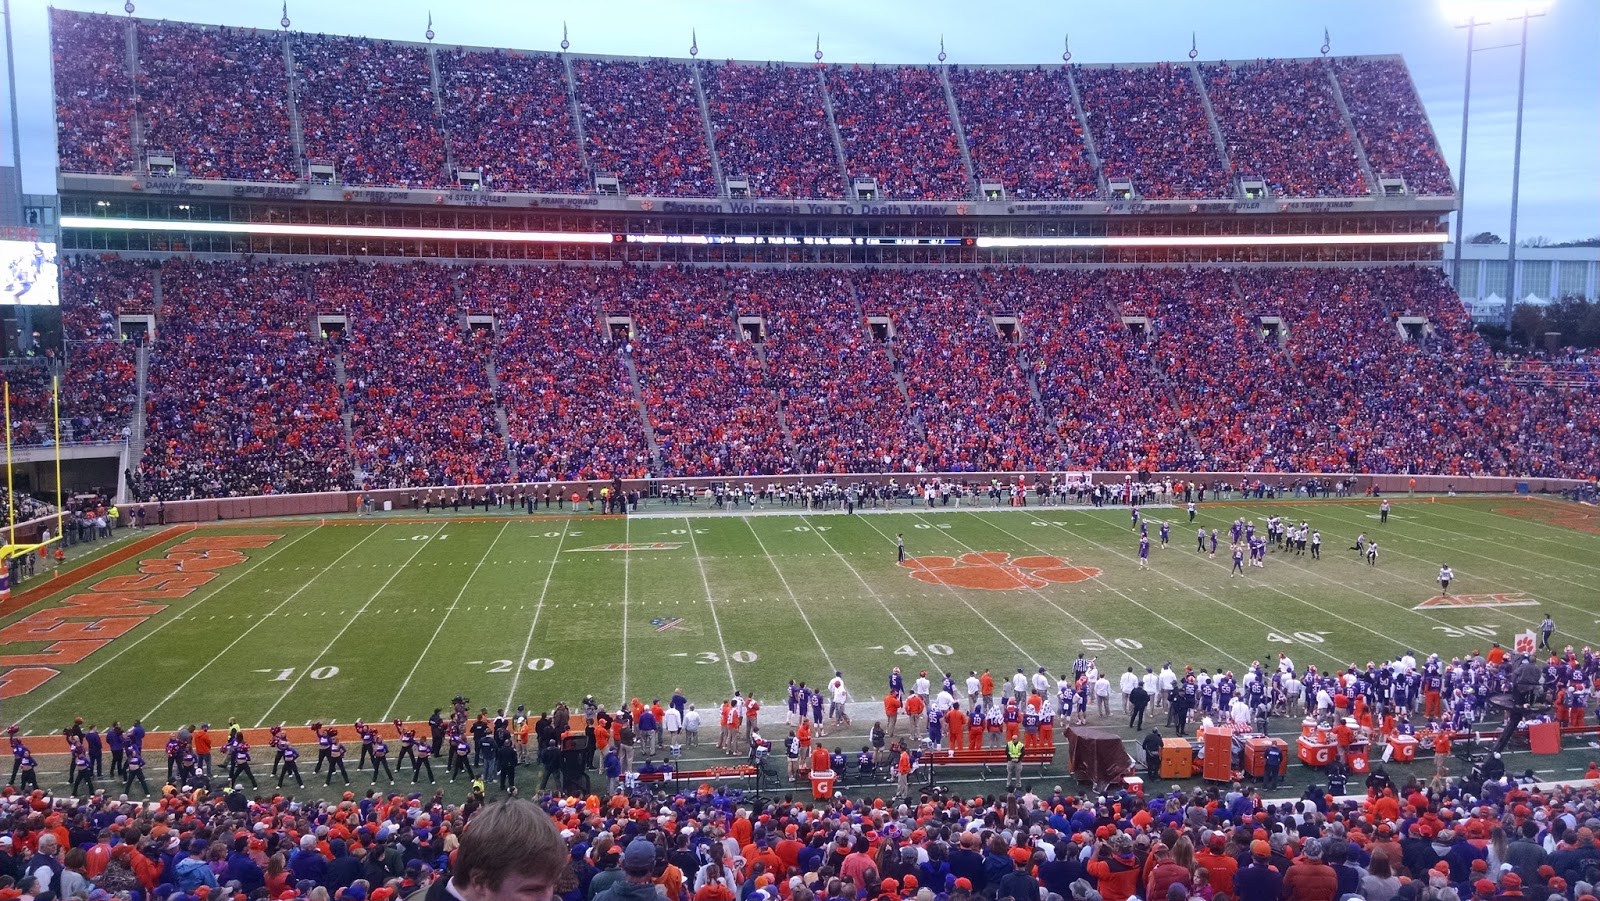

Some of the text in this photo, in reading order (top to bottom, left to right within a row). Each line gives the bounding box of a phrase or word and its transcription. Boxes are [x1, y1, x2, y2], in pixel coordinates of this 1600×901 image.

[146, 181, 177, 189] DANNY
[246, 186, 309, 195] BOB BRADLEY
[662, 201, 948, 216] Clemson Welcomes You To Death Valley
[1267, 631, 1325, 644] 40
[1432, 624, 1497, 638] 30
[894, 644, 954, 656] 40
[1080, 638, 1144, 650] 50
[695, 650, 758, 664] 30
[486, 658, 555, 673] 20
[268, 666, 340, 682] 10
[1316, 748, 1328, 762] G
[1402, 745, 1412, 756] G
[817, 782, 828, 794] G
